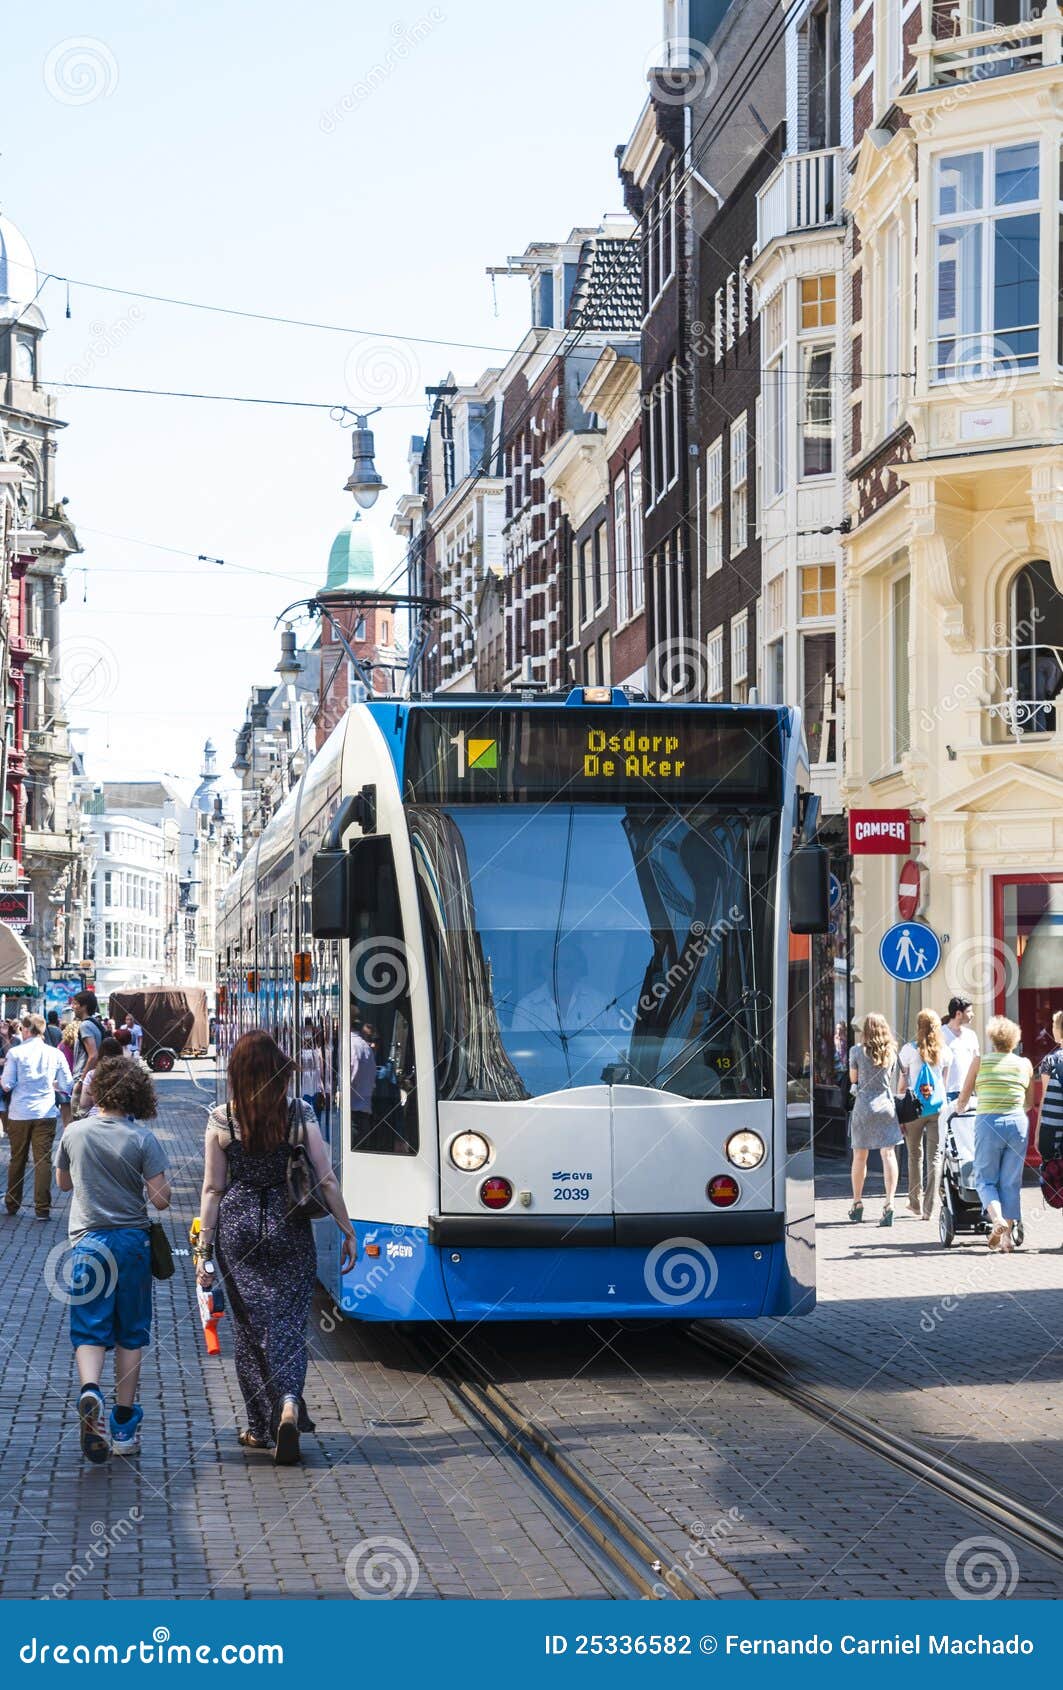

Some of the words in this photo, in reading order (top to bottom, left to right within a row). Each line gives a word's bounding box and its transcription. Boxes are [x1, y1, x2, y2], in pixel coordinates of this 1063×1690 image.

[588, 730, 679, 754] Osdorp
[450, 730, 465, 778] 1
[584, 755, 615, 777] De
[626, 755, 686, 777] Aker
[855, 822, 905, 841] CAMPER
[716, 1057, 731, 1069] 13
[571, 1172, 593, 1181] GVB
[553, 1188, 590, 1201] 2039
